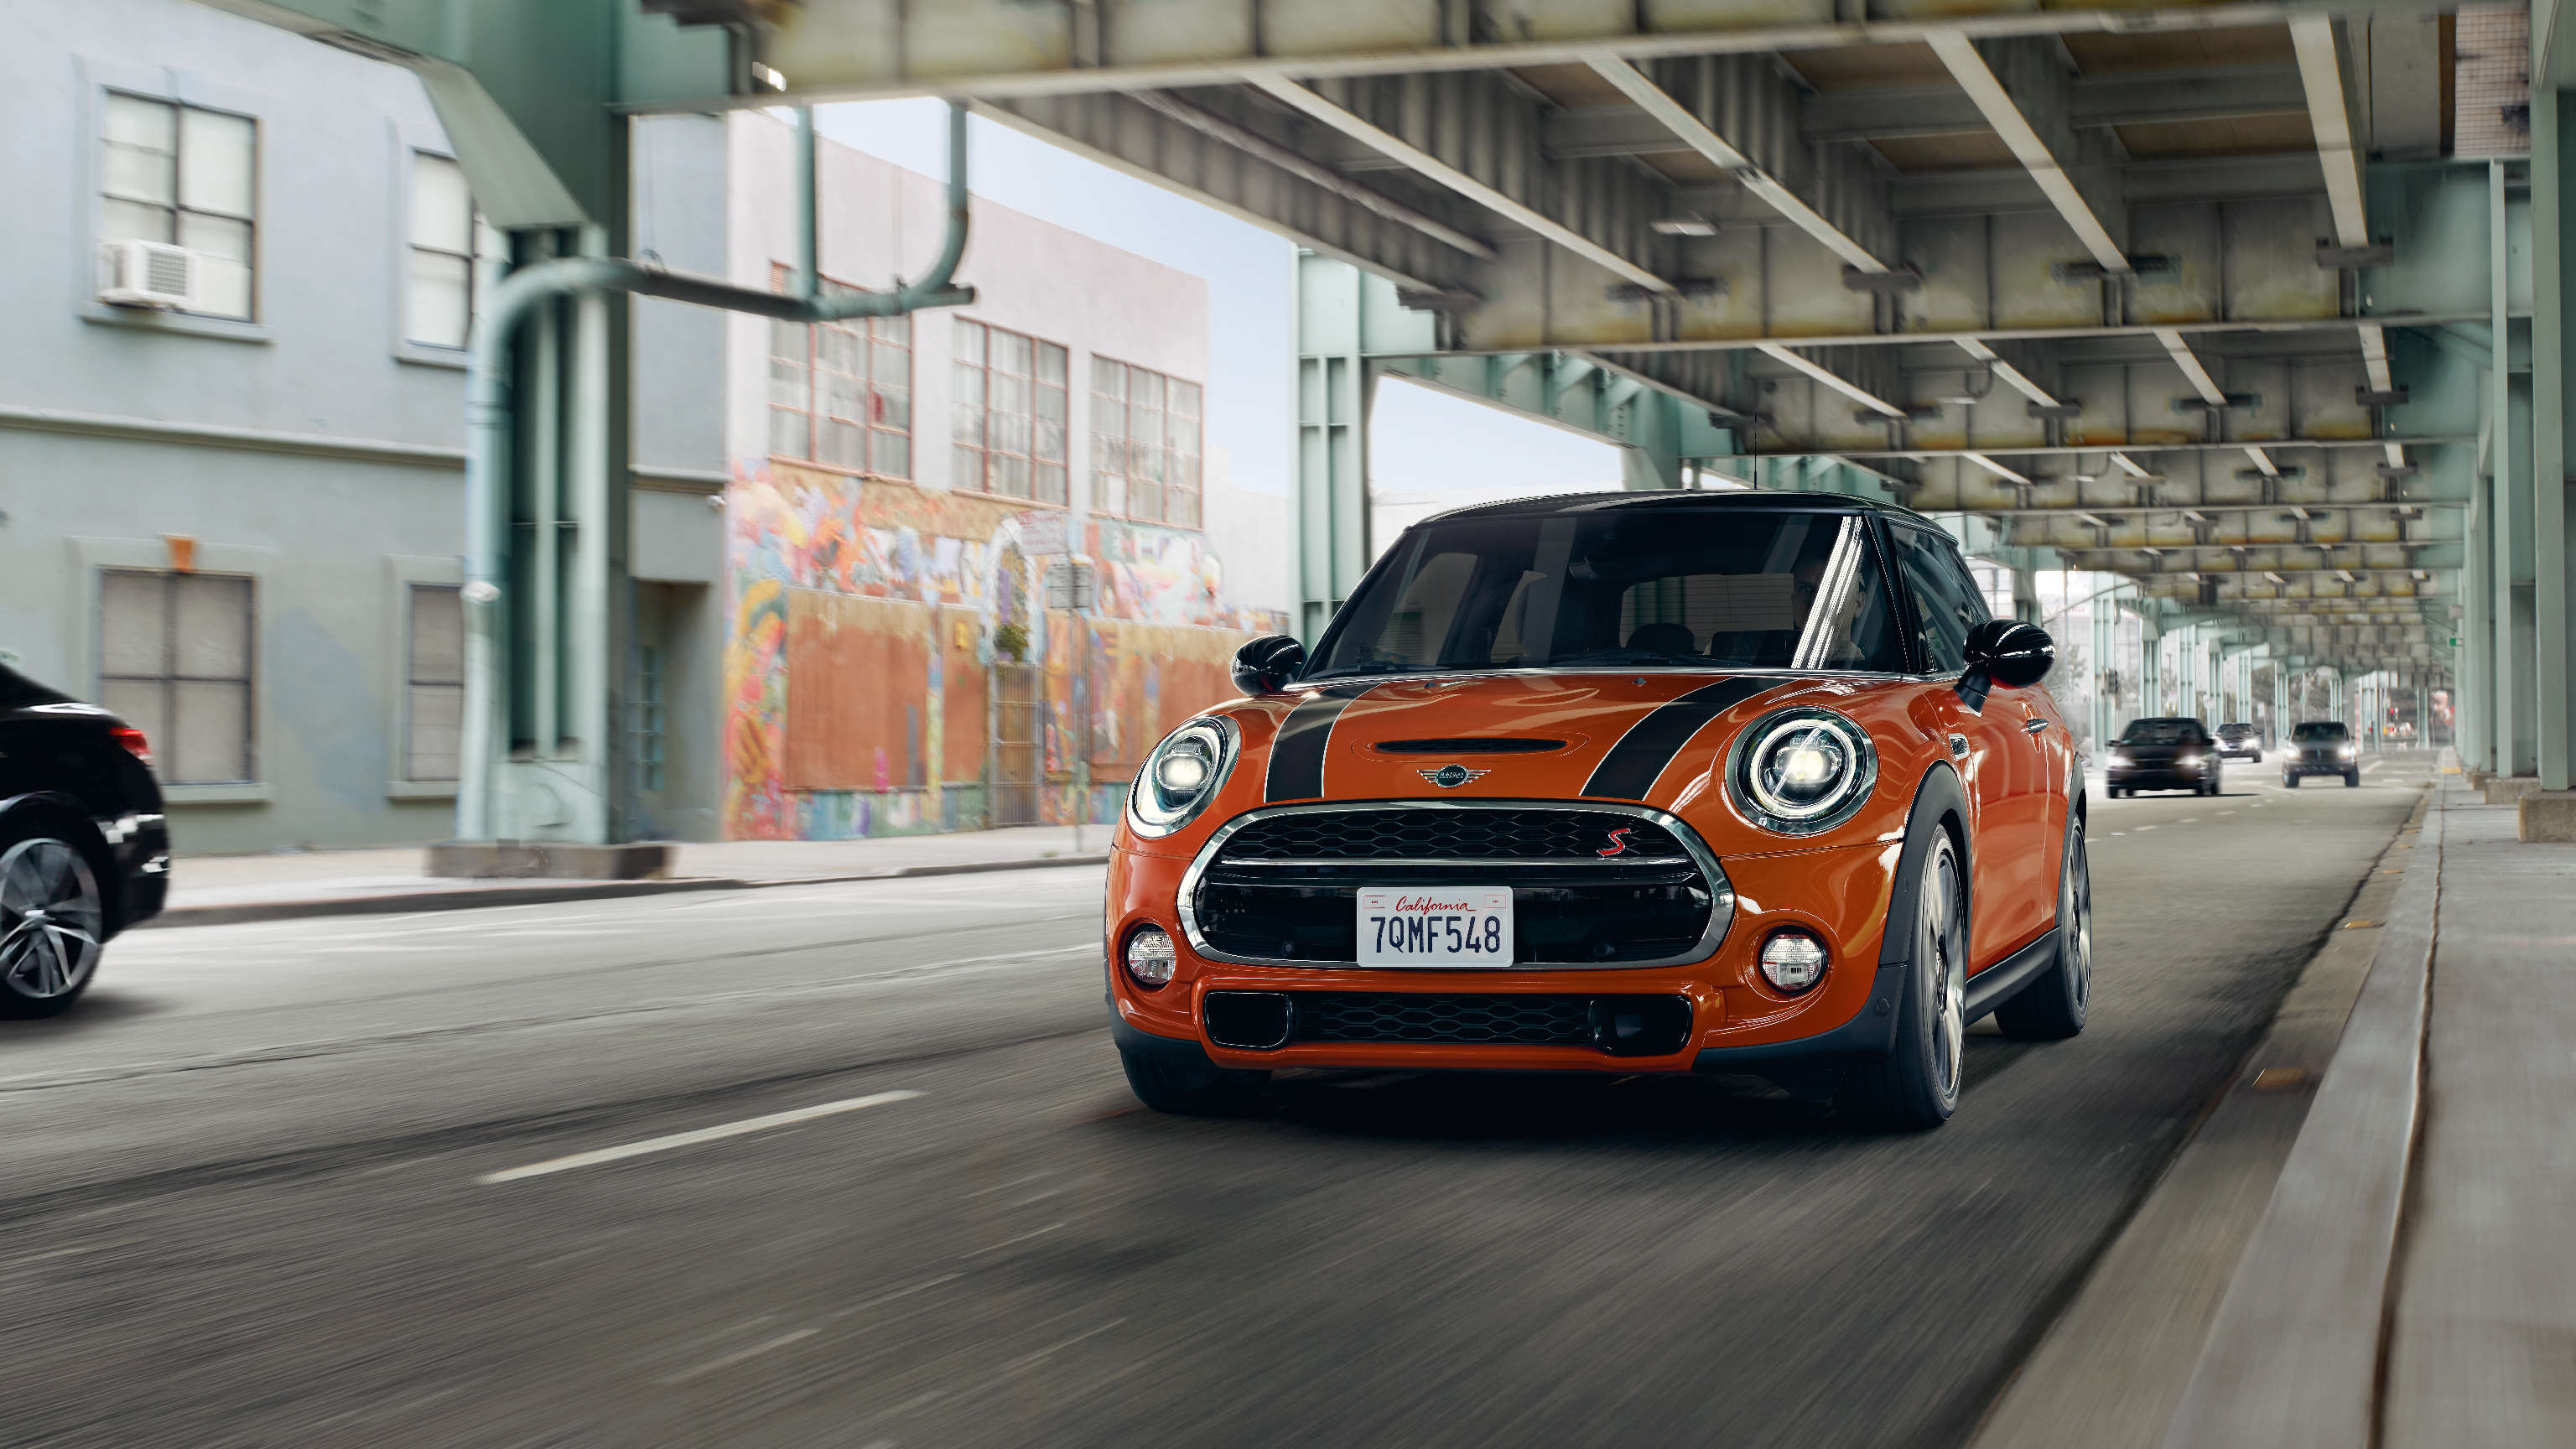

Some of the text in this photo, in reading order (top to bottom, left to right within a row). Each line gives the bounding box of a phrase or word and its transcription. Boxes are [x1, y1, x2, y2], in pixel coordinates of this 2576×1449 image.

[1597, 828, 1630, 856] S
[1395, 896, 1478, 915] California
[1370, 916, 1501, 953] 7QMF548
